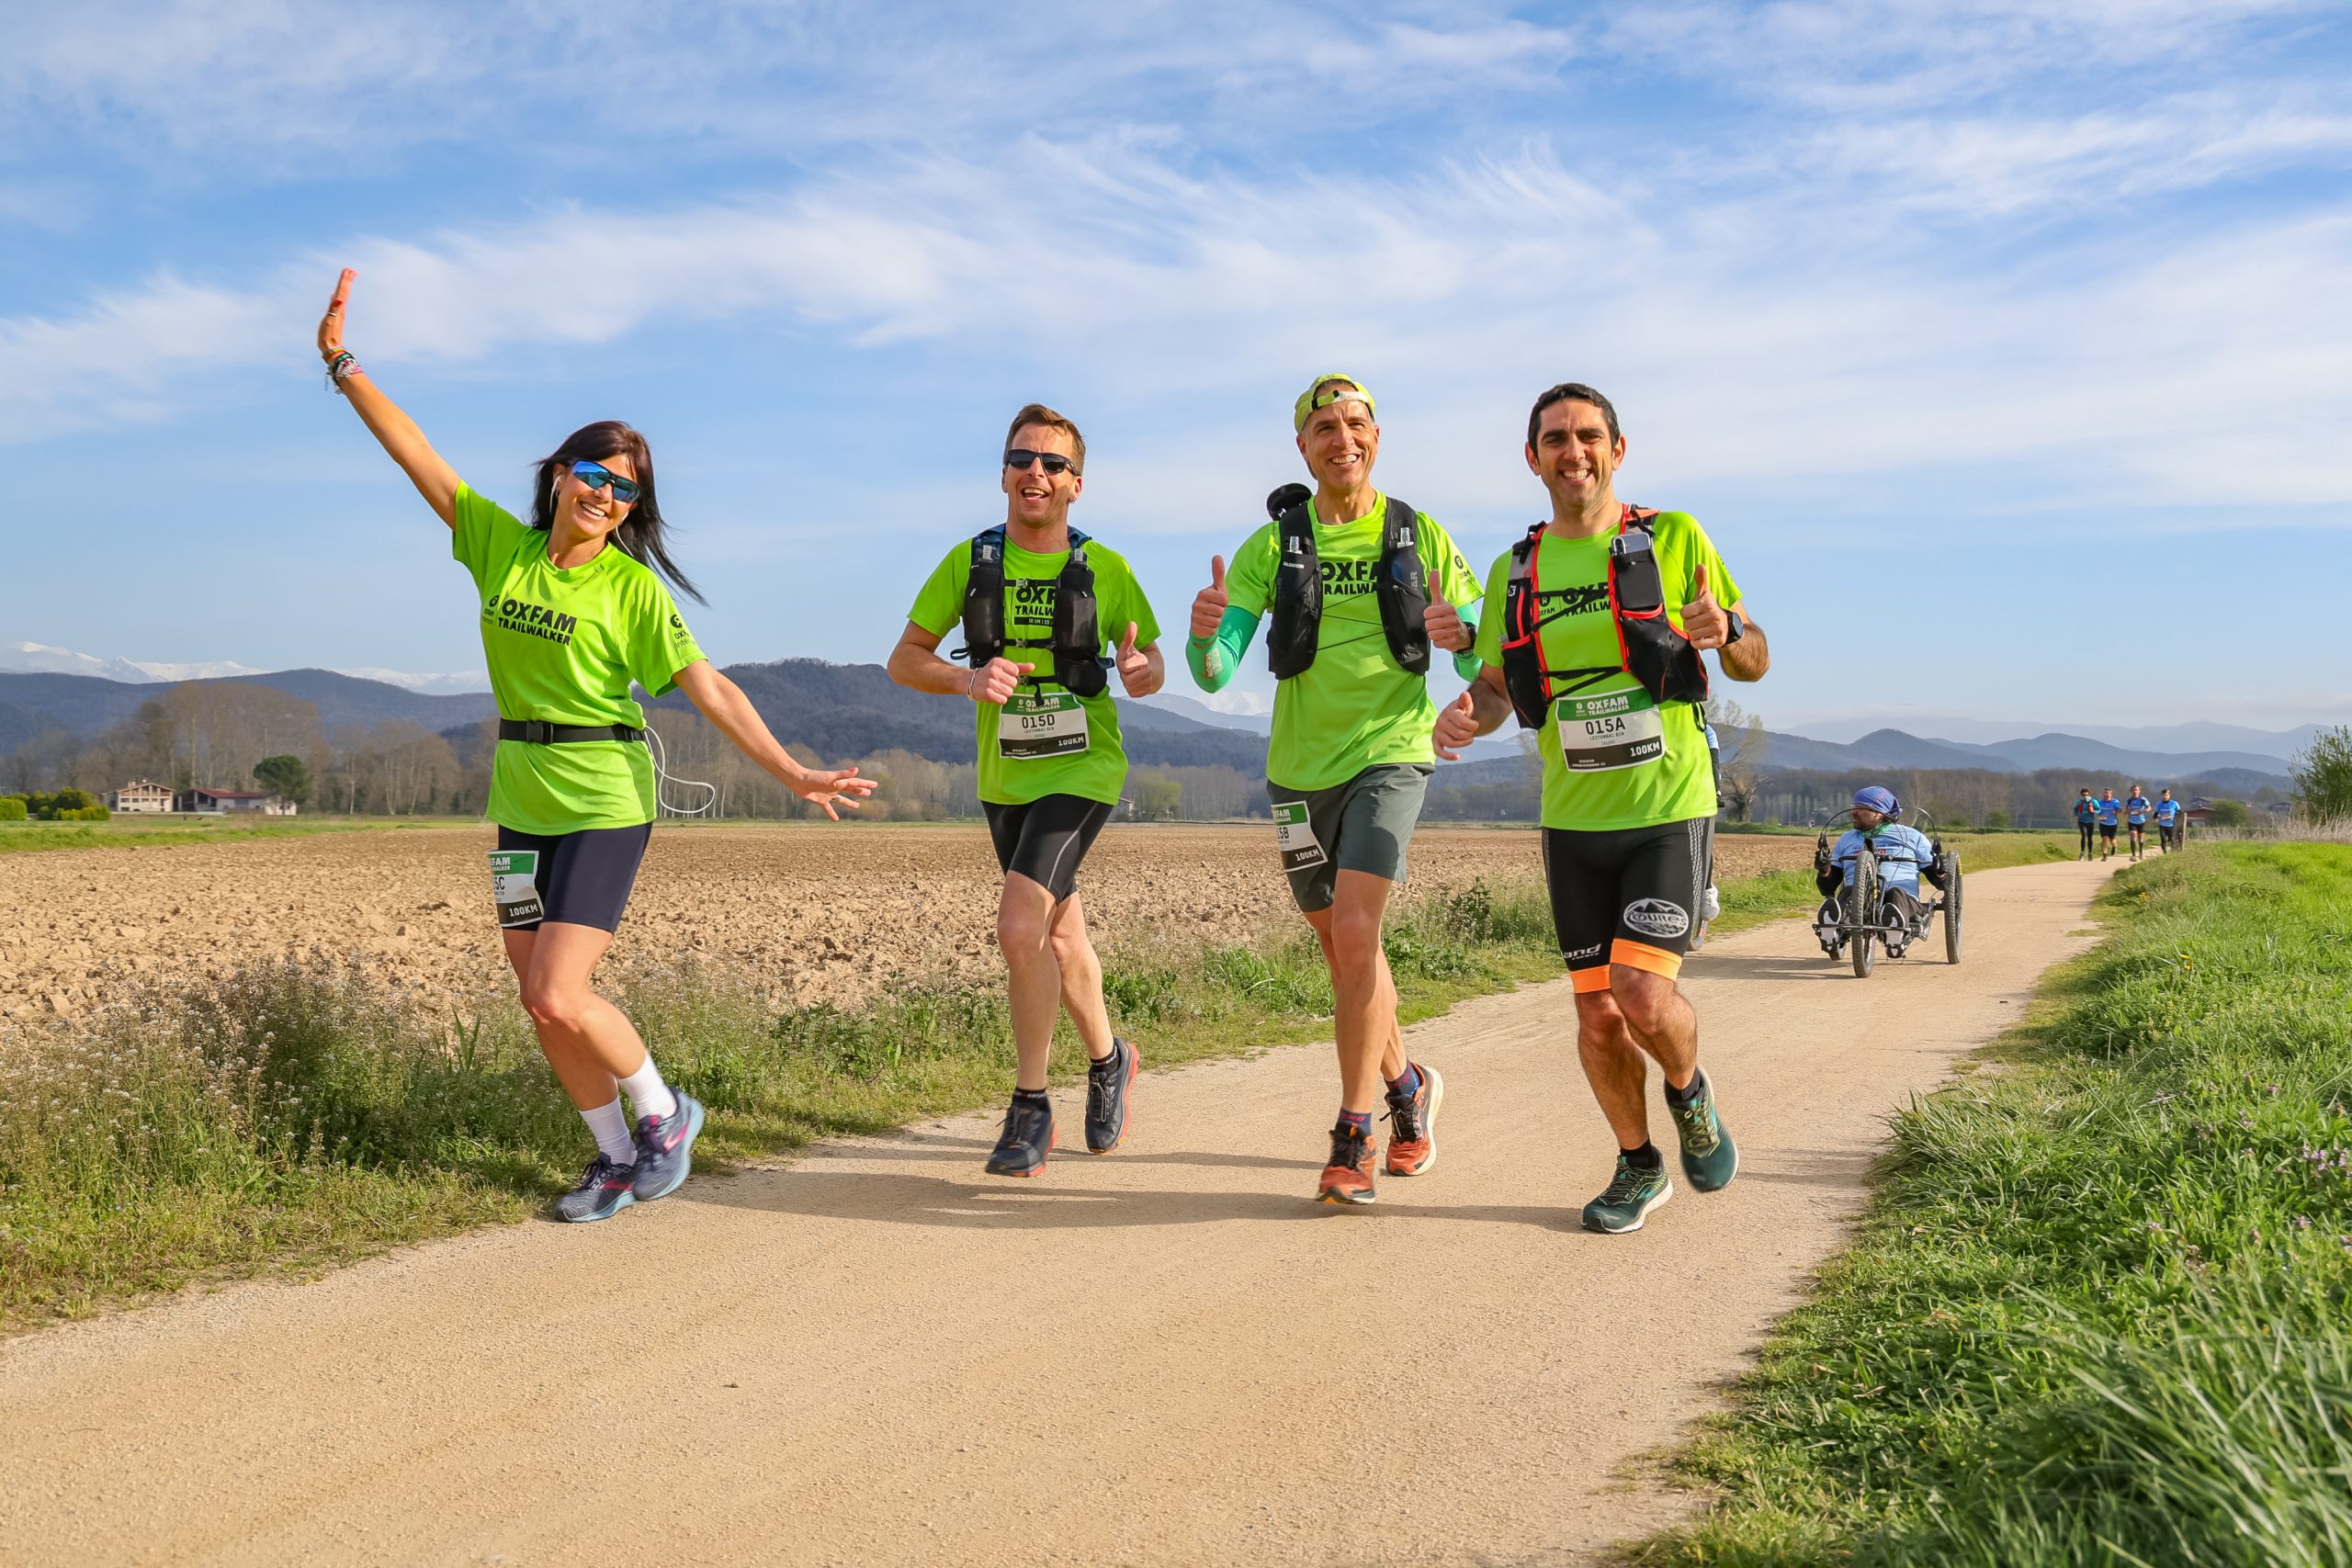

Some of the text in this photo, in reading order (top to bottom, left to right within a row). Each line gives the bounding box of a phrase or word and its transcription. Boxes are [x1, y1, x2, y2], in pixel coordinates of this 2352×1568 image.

[1320, 561, 1380, 581] OXFA
[1016, 587, 1056, 604] OXF
[1324, 582, 1379, 595] RAILWA
[1563, 582, 1610, 604] OXF
[502, 599, 577, 634] OXFAM
[1015, 605, 1055, 616] TRAILW
[498, 616, 571, 646] TRAILWALKER
[1025, 697, 1060, 708] OXAM
[1025, 704, 1060, 713] TRAILWALKER
[1587, 695, 1629, 710] OXFAM
[1588, 705, 1630, 716] TRAILWALKER
[1022, 714, 1056, 729] 015D
[1585, 716, 1626, 735] 015A
[1057, 736, 1085, 747] 100KM
[1630, 741, 1660, 757] 100KM
[1295, 848, 1320, 862] 100KM
[509, 903, 538, 917] 100KM
